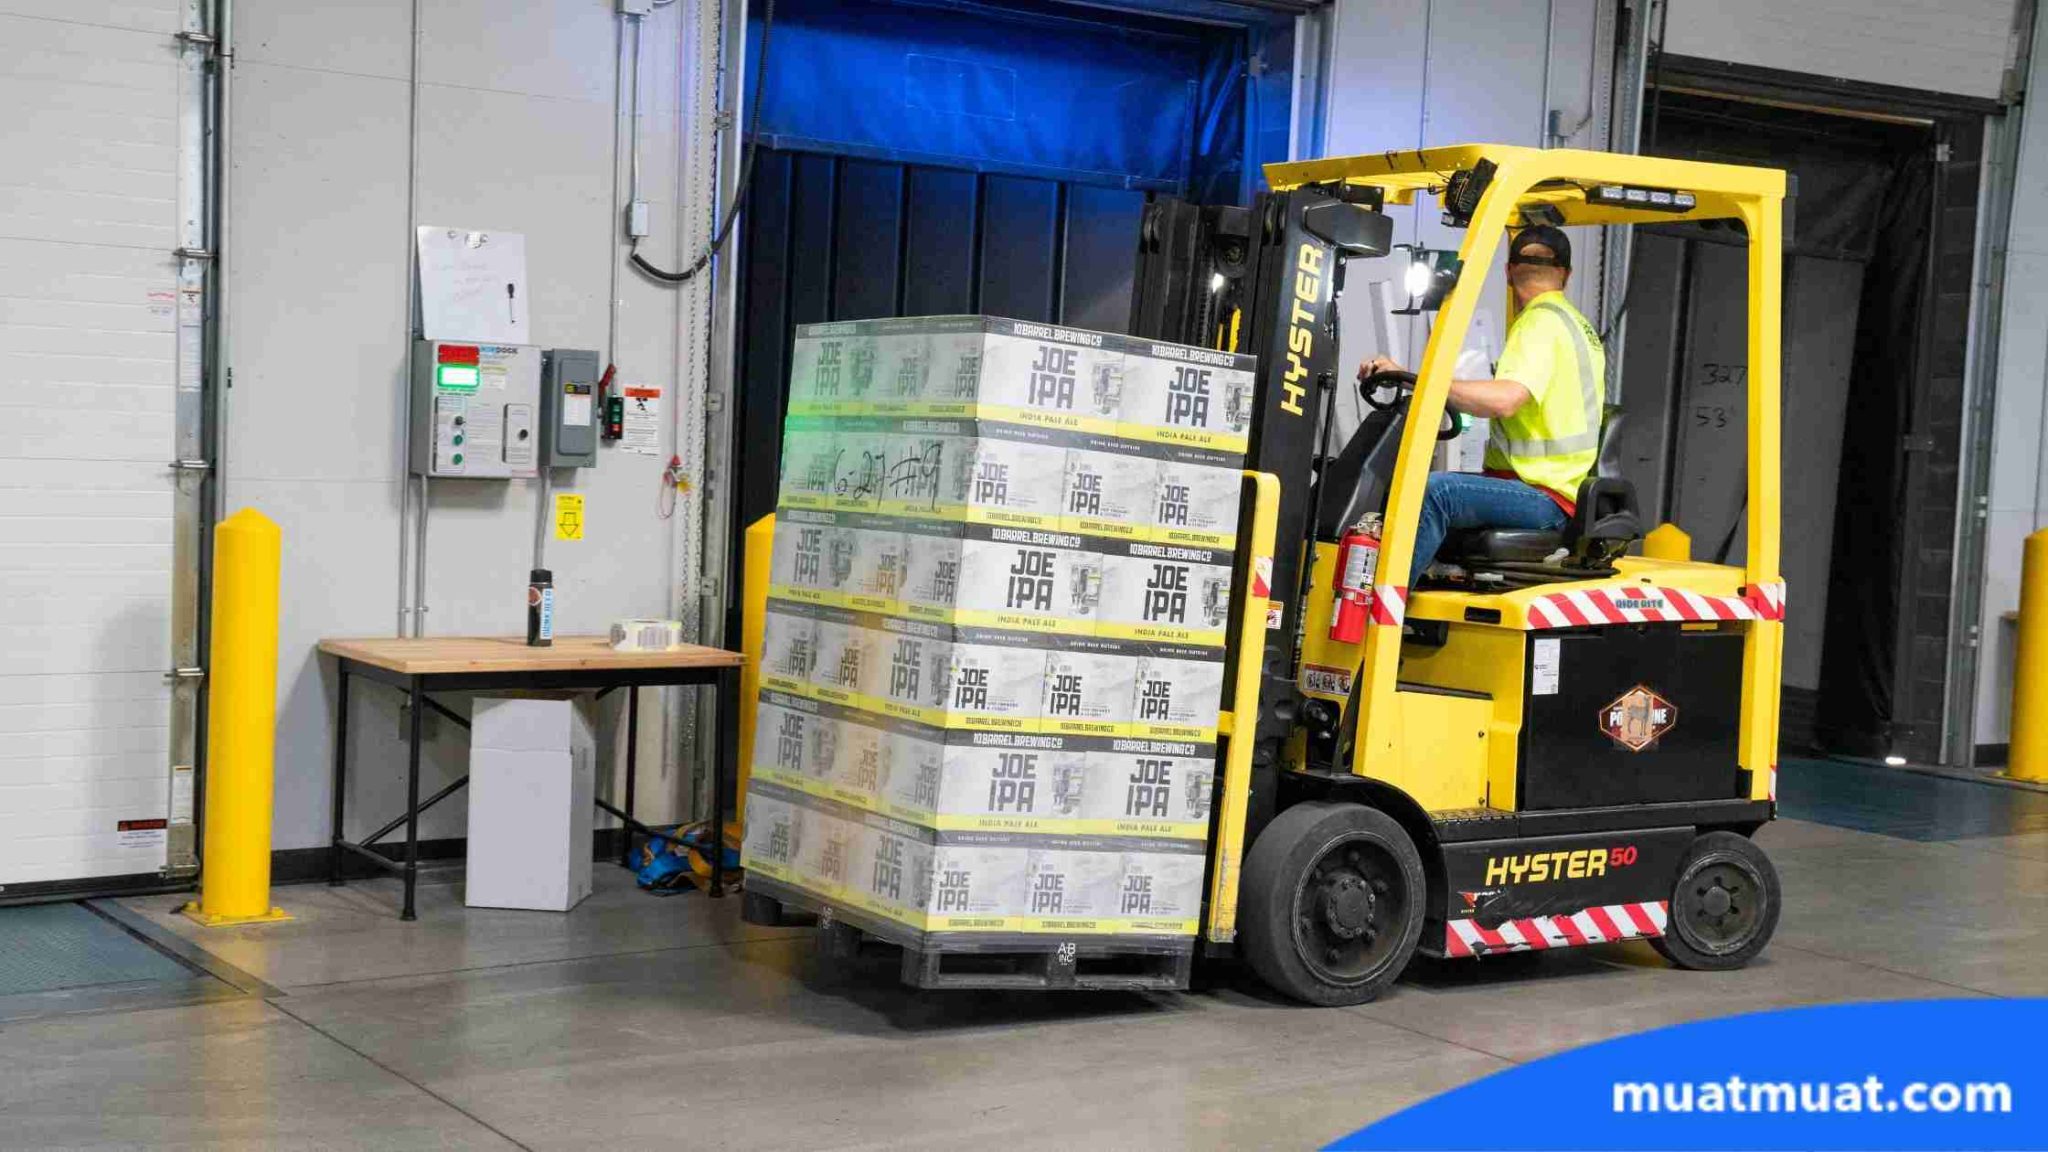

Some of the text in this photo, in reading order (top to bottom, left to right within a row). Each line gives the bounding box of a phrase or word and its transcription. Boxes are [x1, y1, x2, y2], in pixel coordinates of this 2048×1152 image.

[1280, 243, 1323, 417] HYSTER
[818, 342, 843, 365] JOE
[1032, 345, 1078, 376] JOE
[954, 375, 976, 398] IPA
[1168, 366, 1212, 395] JOE
[1701, 363, 1747, 386] 327
[1028, 372, 1076, 410] IPA
[1165, 392, 1209, 428] IPA
[1156, 430, 1212, 443] INDIA PALE ALE
[977, 462, 1008, 482] JOE
[1072, 472, 1103, 493] JOE
[975, 481, 1007, 505] IPA
[1070, 490, 1100, 516] IPA
[1162, 484, 1190, 504] JOE
[1158, 501, 1188, 526] IPA
[797, 528, 822, 553] JOE
[794, 553, 820, 584] IPA
[878, 554, 898, 571] JOE
[935, 561, 956, 579] JOE
[1010, 549, 1057, 578] JOE
[876, 572, 896, 595] IPA
[1147, 563, 1189, 591] JOE
[932, 579, 955, 603] IPA
[1007, 575, 1054, 611] IPA
[1142, 589, 1187, 624] IPA
[1134, 628, 1189, 639] INDIA PALE ALE
[893, 640, 922, 667] JOE
[839, 665, 858, 689] IPA
[890, 665, 920, 701] IPA
[957, 668, 989, 687] JOE
[1052, 674, 1083, 693] JOE
[1142, 680, 1172, 698] JOE
[954, 686, 987, 710] IPA
[1050, 693, 1081, 716] IPA
[1140, 698, 1169, 721] IPA
[779, 712, 804, 739] JOE
[777, 737, 803, 770] IPA
[991, 752, 1038, 780] JOE
[1130, 758, 1173, 785] JOE
[988, 779, 1036, 813] IPA
[1125, 784, 1170, 817] IPA
[1485, 846, 1638, 886] HYSTER 50
[873, 861, 903, 900] IPA
[939, 870, 971, 889] JOE
[1034, 873, 1065, 891] JOE
[1123, 875, 1153, 893] JOE
[937, 889, 969, 912] IPA
[1031, 891, 1063, 914] IPA
[1121, 893, 1151, 914] IPA
